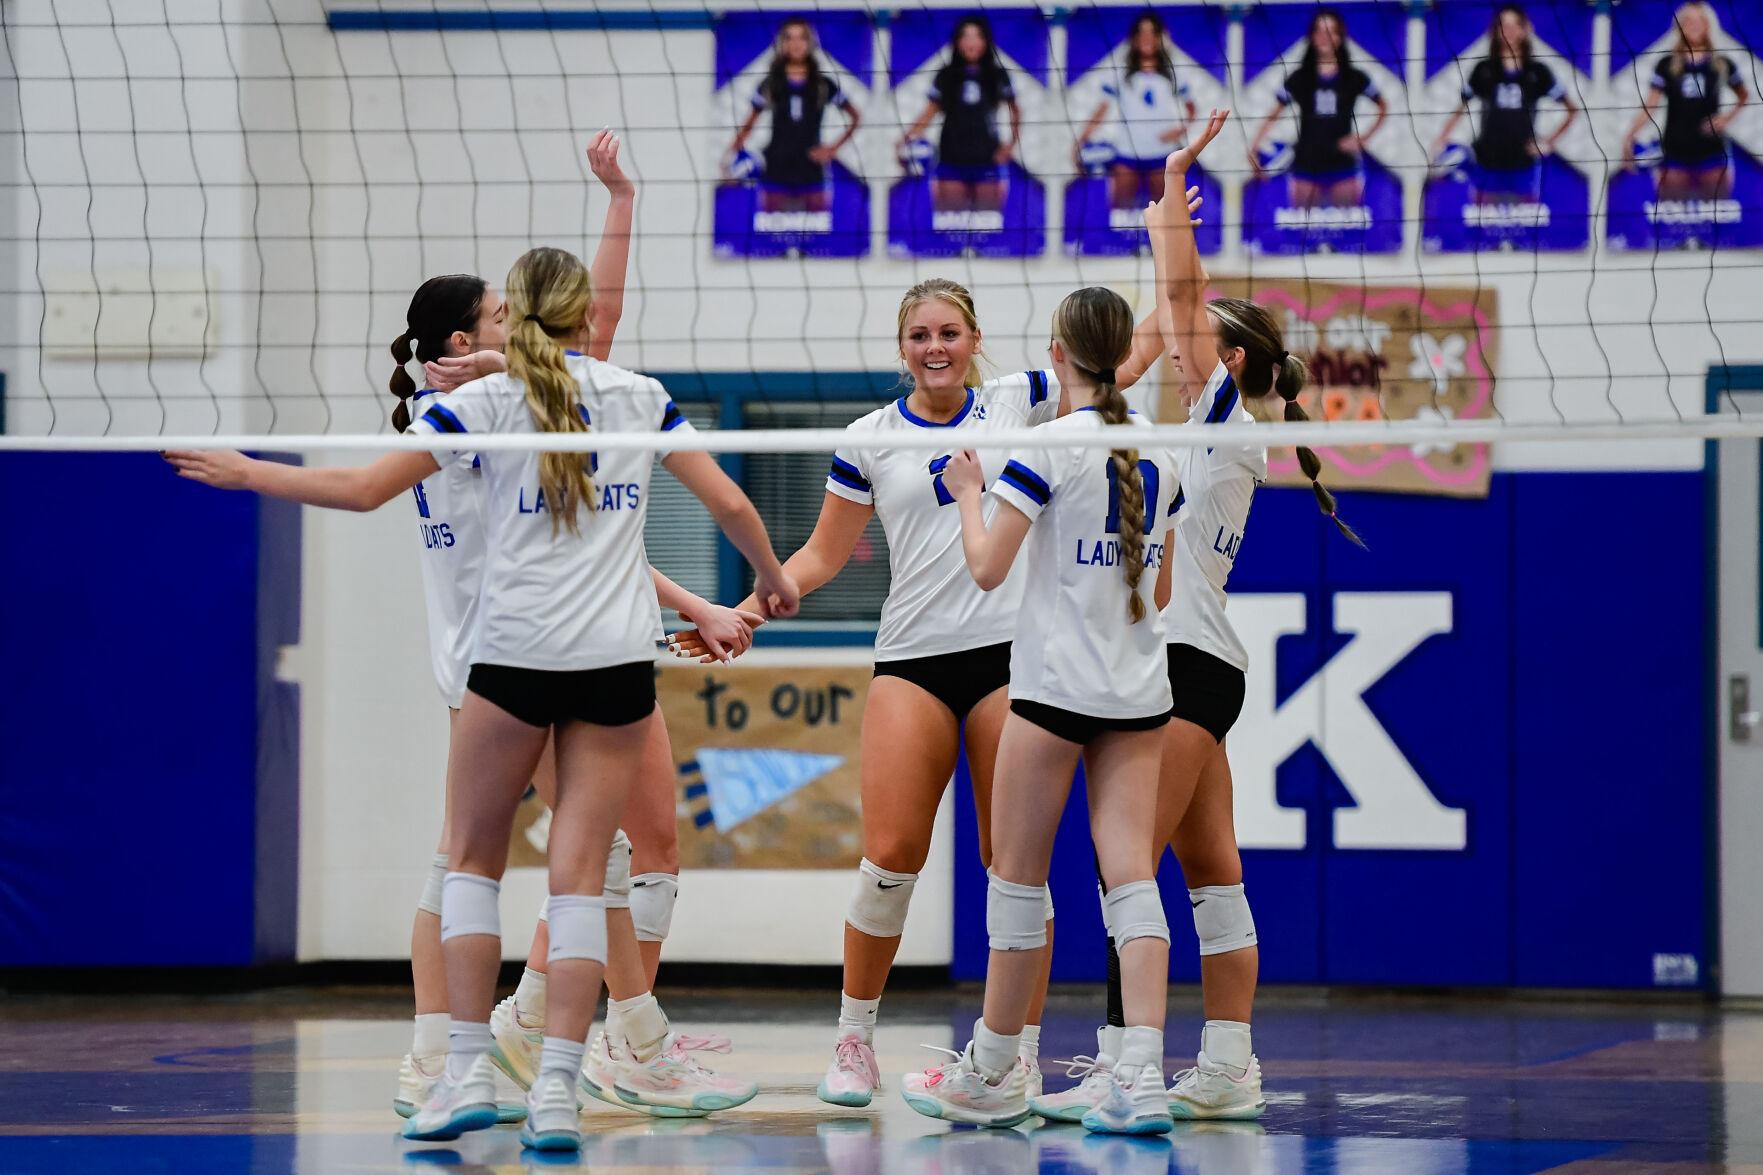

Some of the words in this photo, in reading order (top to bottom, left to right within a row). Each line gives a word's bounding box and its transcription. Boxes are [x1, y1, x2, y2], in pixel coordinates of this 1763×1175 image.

[1309, 348, 1389, 388] nior
[1141, 543, 1164, 569] ATS
[1213, 525, 1241, 560] LAD
[696, 674, 749, 731] to
[769, 683, 856, 727] our
[1226, 591, 1467, 851] K
